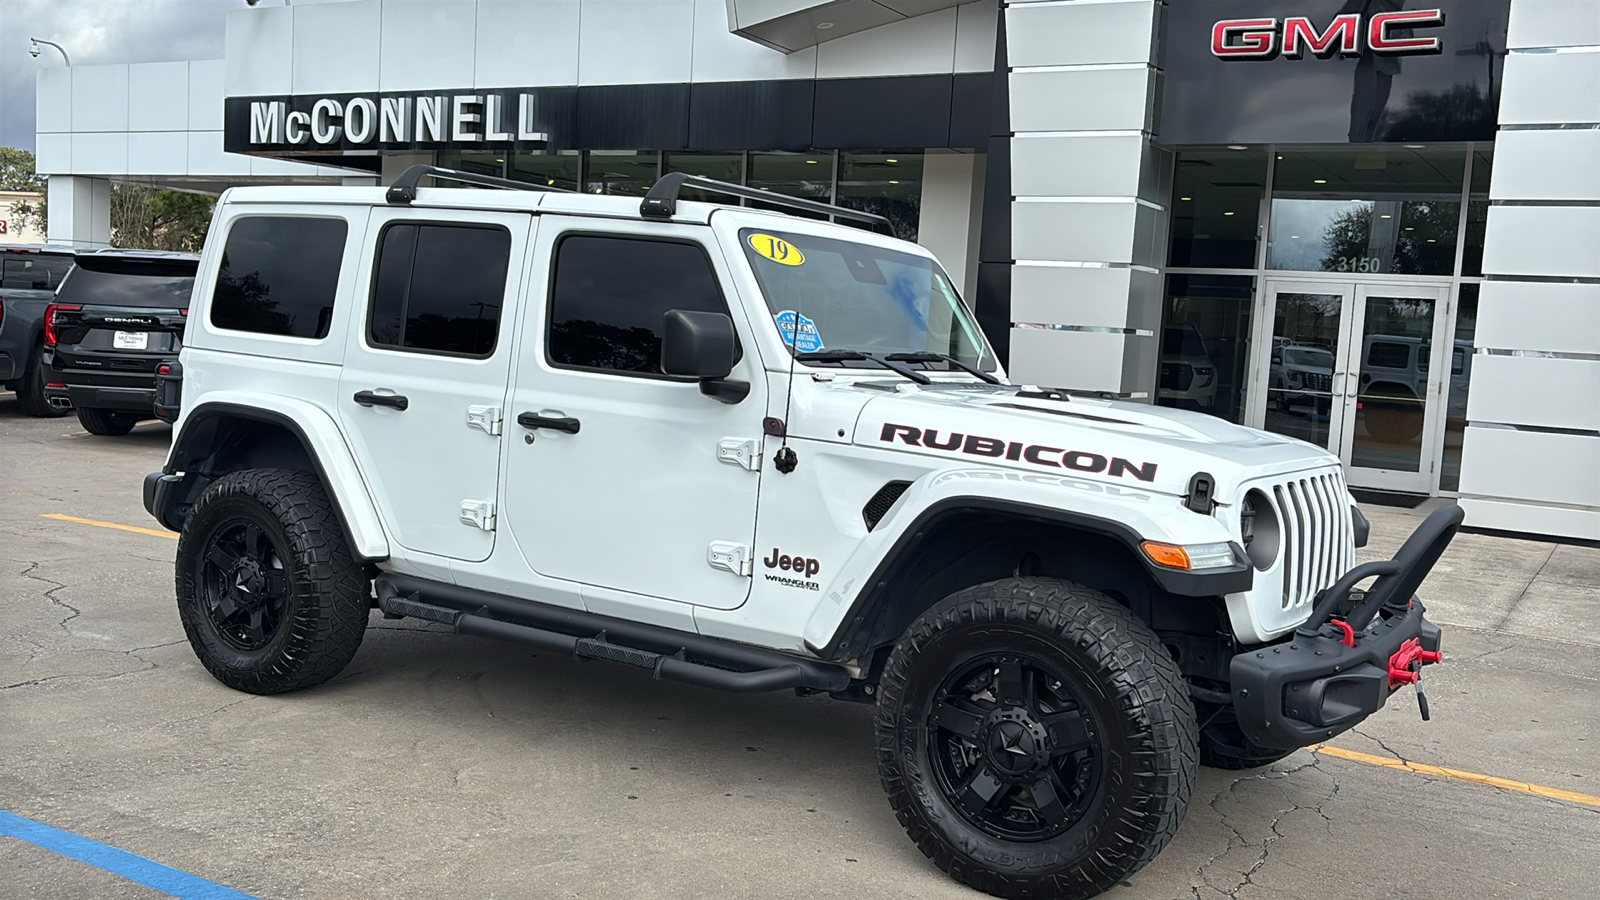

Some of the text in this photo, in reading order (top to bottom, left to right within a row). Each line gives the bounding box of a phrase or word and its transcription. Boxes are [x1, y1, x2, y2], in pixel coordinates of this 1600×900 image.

[1211, 8, 1444, 59] GMC
[249, 93, 548, 144] McCONNELL
[768, 238, 788, 260] 19
[1338, 256, 1380, 273] 3150
[879, 422, 1158, 483] RUBICON
[763, 547, 820, 578] Jeep
[764, 574, 820, 588] WRANGLER
